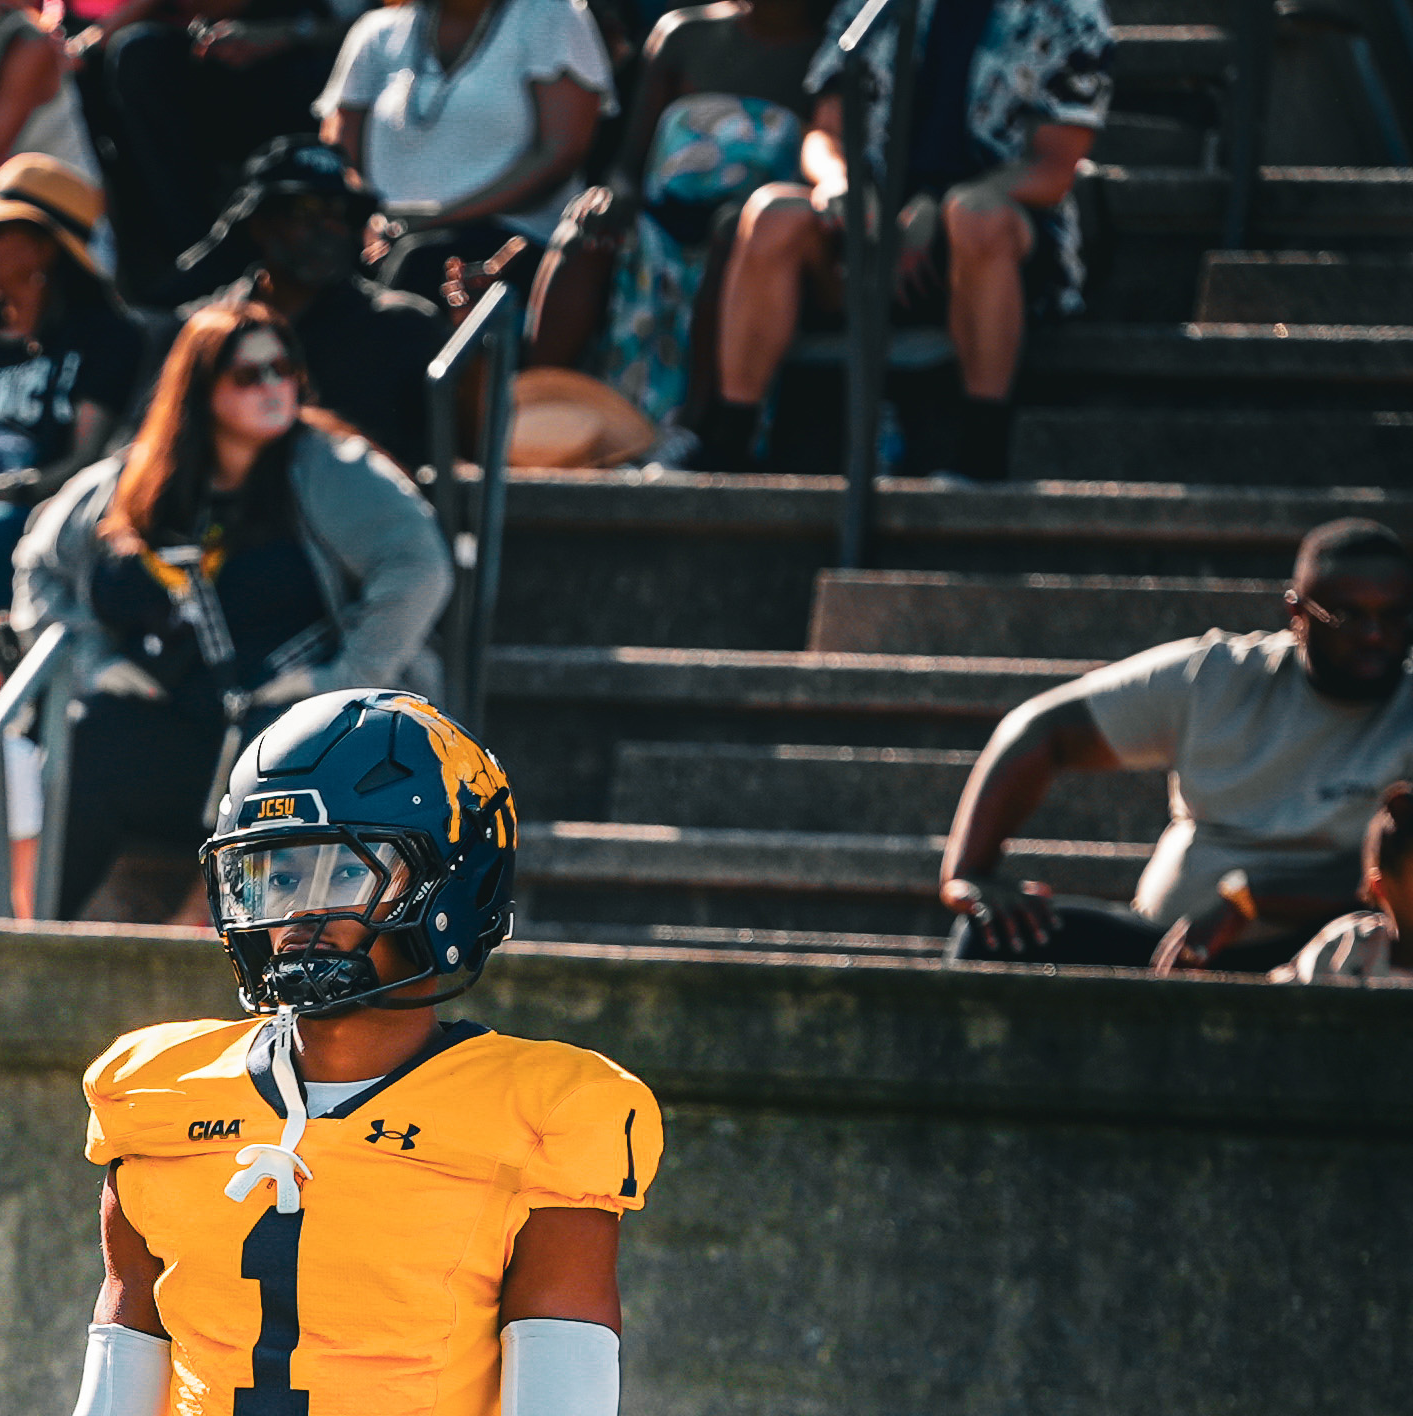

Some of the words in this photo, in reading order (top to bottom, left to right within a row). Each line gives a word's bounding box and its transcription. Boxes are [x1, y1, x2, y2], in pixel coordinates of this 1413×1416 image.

[257, 797, 295, 818] JCSU
[188, 1119, 241, 1141] CIAA
[618, 1108, 638, 1198] 1
